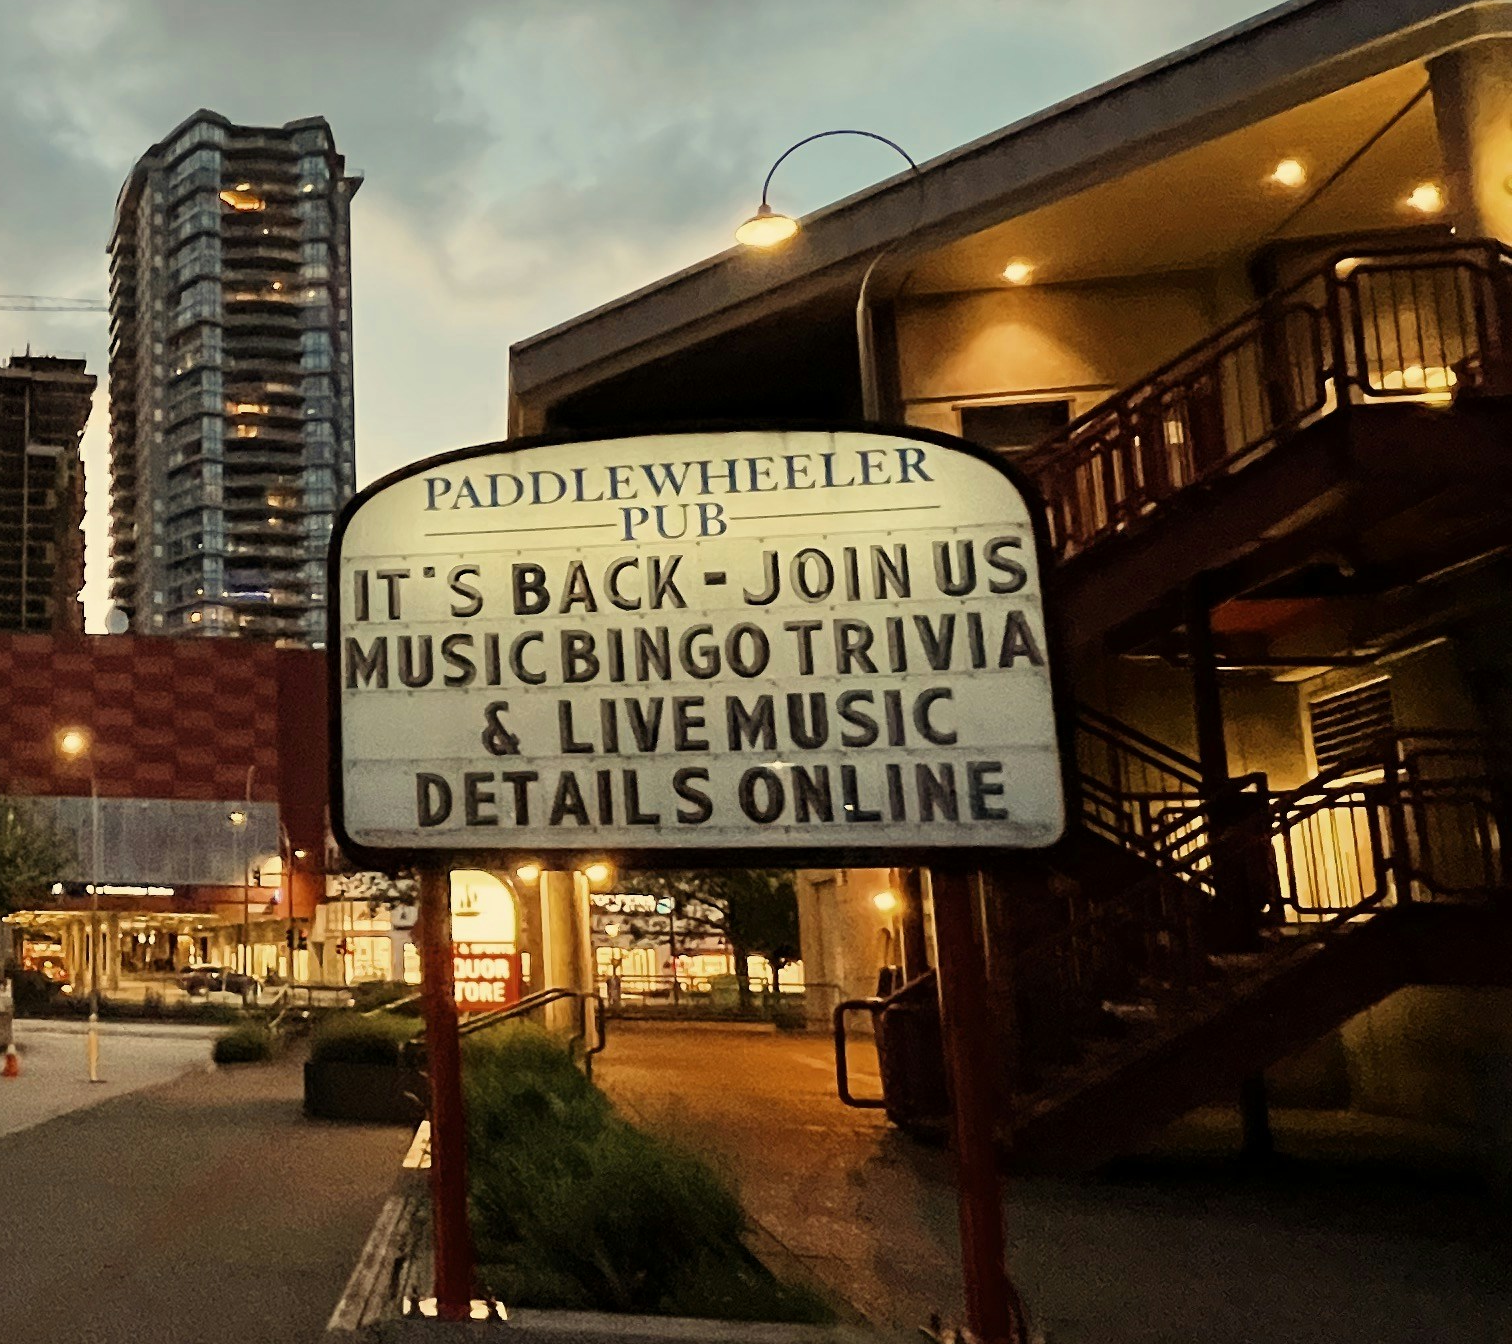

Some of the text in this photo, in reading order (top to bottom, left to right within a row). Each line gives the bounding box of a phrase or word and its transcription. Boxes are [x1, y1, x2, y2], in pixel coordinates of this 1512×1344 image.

[424, 447, 934, 512] PADDLEWHEELER
[619, 502, 728, 542] PUB
[354, 564, 483, 622] IT'S
[513, 554, 688, 615] BACK
[743, 544, 912, 606] JOIN
[933, 536, 1028, 597] US
[785, 610, 1046, 675] TRIVIA
[482, 687, 958, 756] & LIVE MUSIC
[416, 760, 1008, 828] DETAILS ONLINE
[453, 958, 510, 979] QUOR
[454, 981, 506, 1002] TORE
